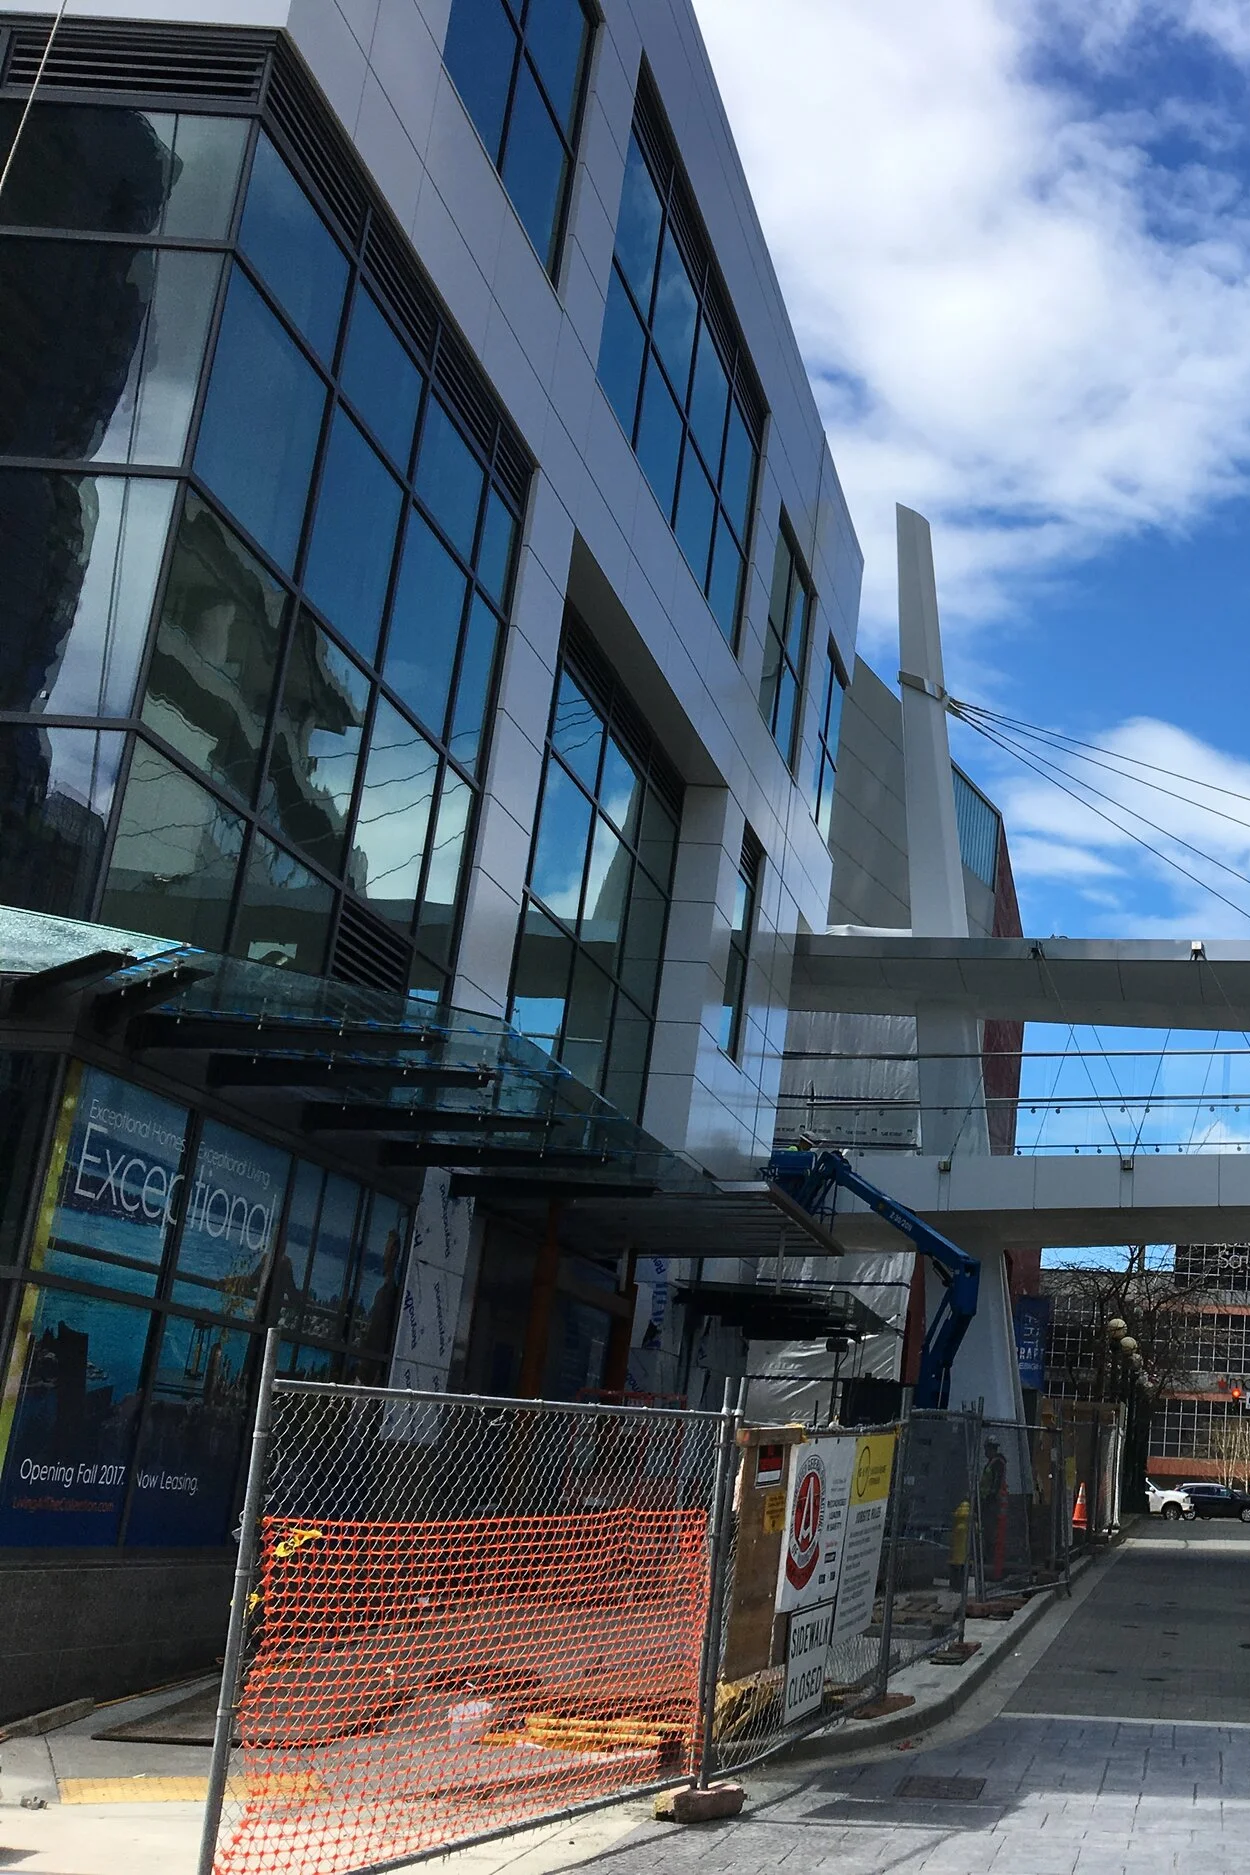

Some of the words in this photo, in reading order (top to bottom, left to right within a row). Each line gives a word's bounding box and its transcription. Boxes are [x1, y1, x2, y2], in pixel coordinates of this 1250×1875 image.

[89, 1098, 150, 1139] Exceptional
[151, 1124, 187, 1153] Homes
[197, 1140, 249, 1176] Exceptional
[246, 1163, 271, 1190] Living
[74, 1121, 277, 1253] Exceptional
[20, 1458, 75, 1488] Opening
[76, 1463, 97, 1484] Fall
[98, 1464, 126, 1486] 2017.
[159, 1471, 200, 1496] Leasing.
[790, 1615, 831, 1660] SIDEWALK
[788, 1665, 823, 1710] CLOSED
